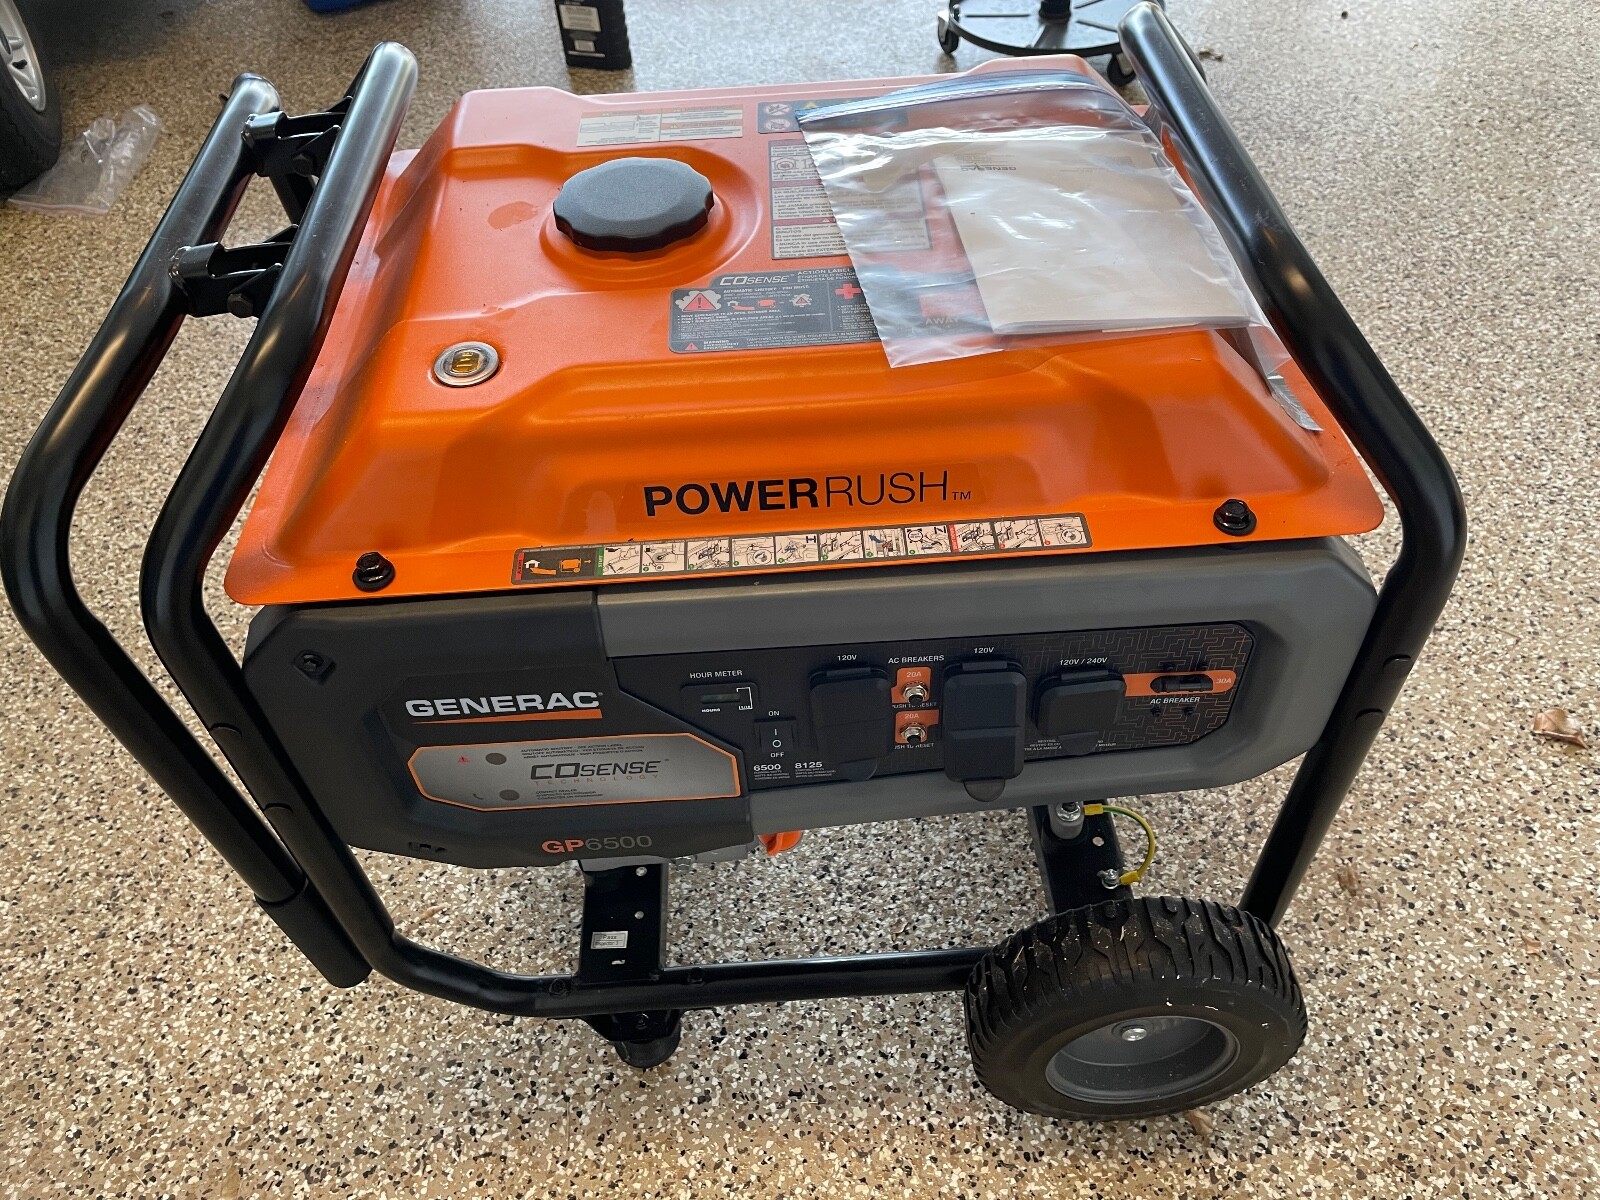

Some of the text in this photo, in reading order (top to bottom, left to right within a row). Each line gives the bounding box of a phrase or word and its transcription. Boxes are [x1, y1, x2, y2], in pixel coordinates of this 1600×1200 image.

[644, 471, 948, 517] POWERRUSH
[901, 655, 944, 663] BREAKERS
[714, 670, 743, 678] METER
[405, 692, 600, 717] GENERAC
[530, 760, 661, 780] COSENSE
[753, 764, 782, 772] 6500
[534, 774, 659, 785] TECHNOLOGY
[541, 835, 653, 854] GP6500
